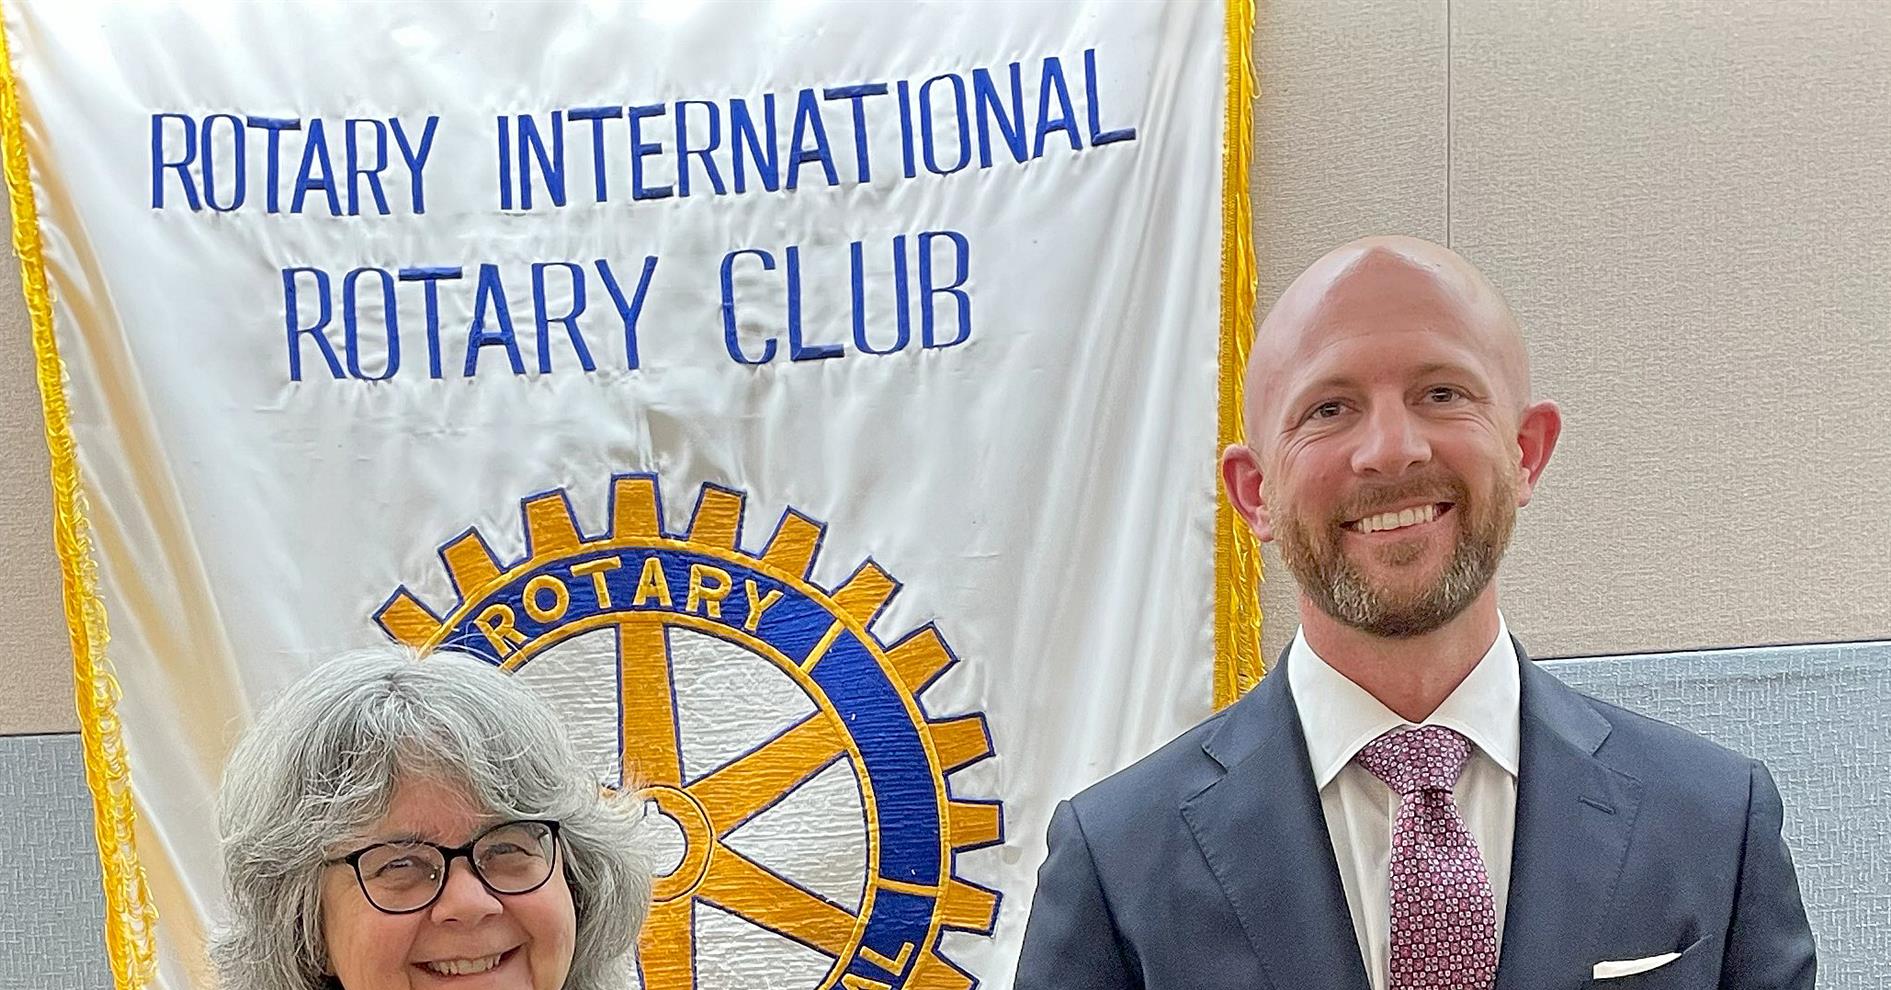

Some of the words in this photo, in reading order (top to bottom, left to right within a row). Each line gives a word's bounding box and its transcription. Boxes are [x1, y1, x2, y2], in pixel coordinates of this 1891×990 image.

[152, 114, 439, 216] ROTARY
[498, 48, 1137, 210] INTERNATIONAL
[283, 256, 658, 381] ROTARY
[720, 231, 974, 365] CLUB
[474, 556, 784, 659] ROTARY
